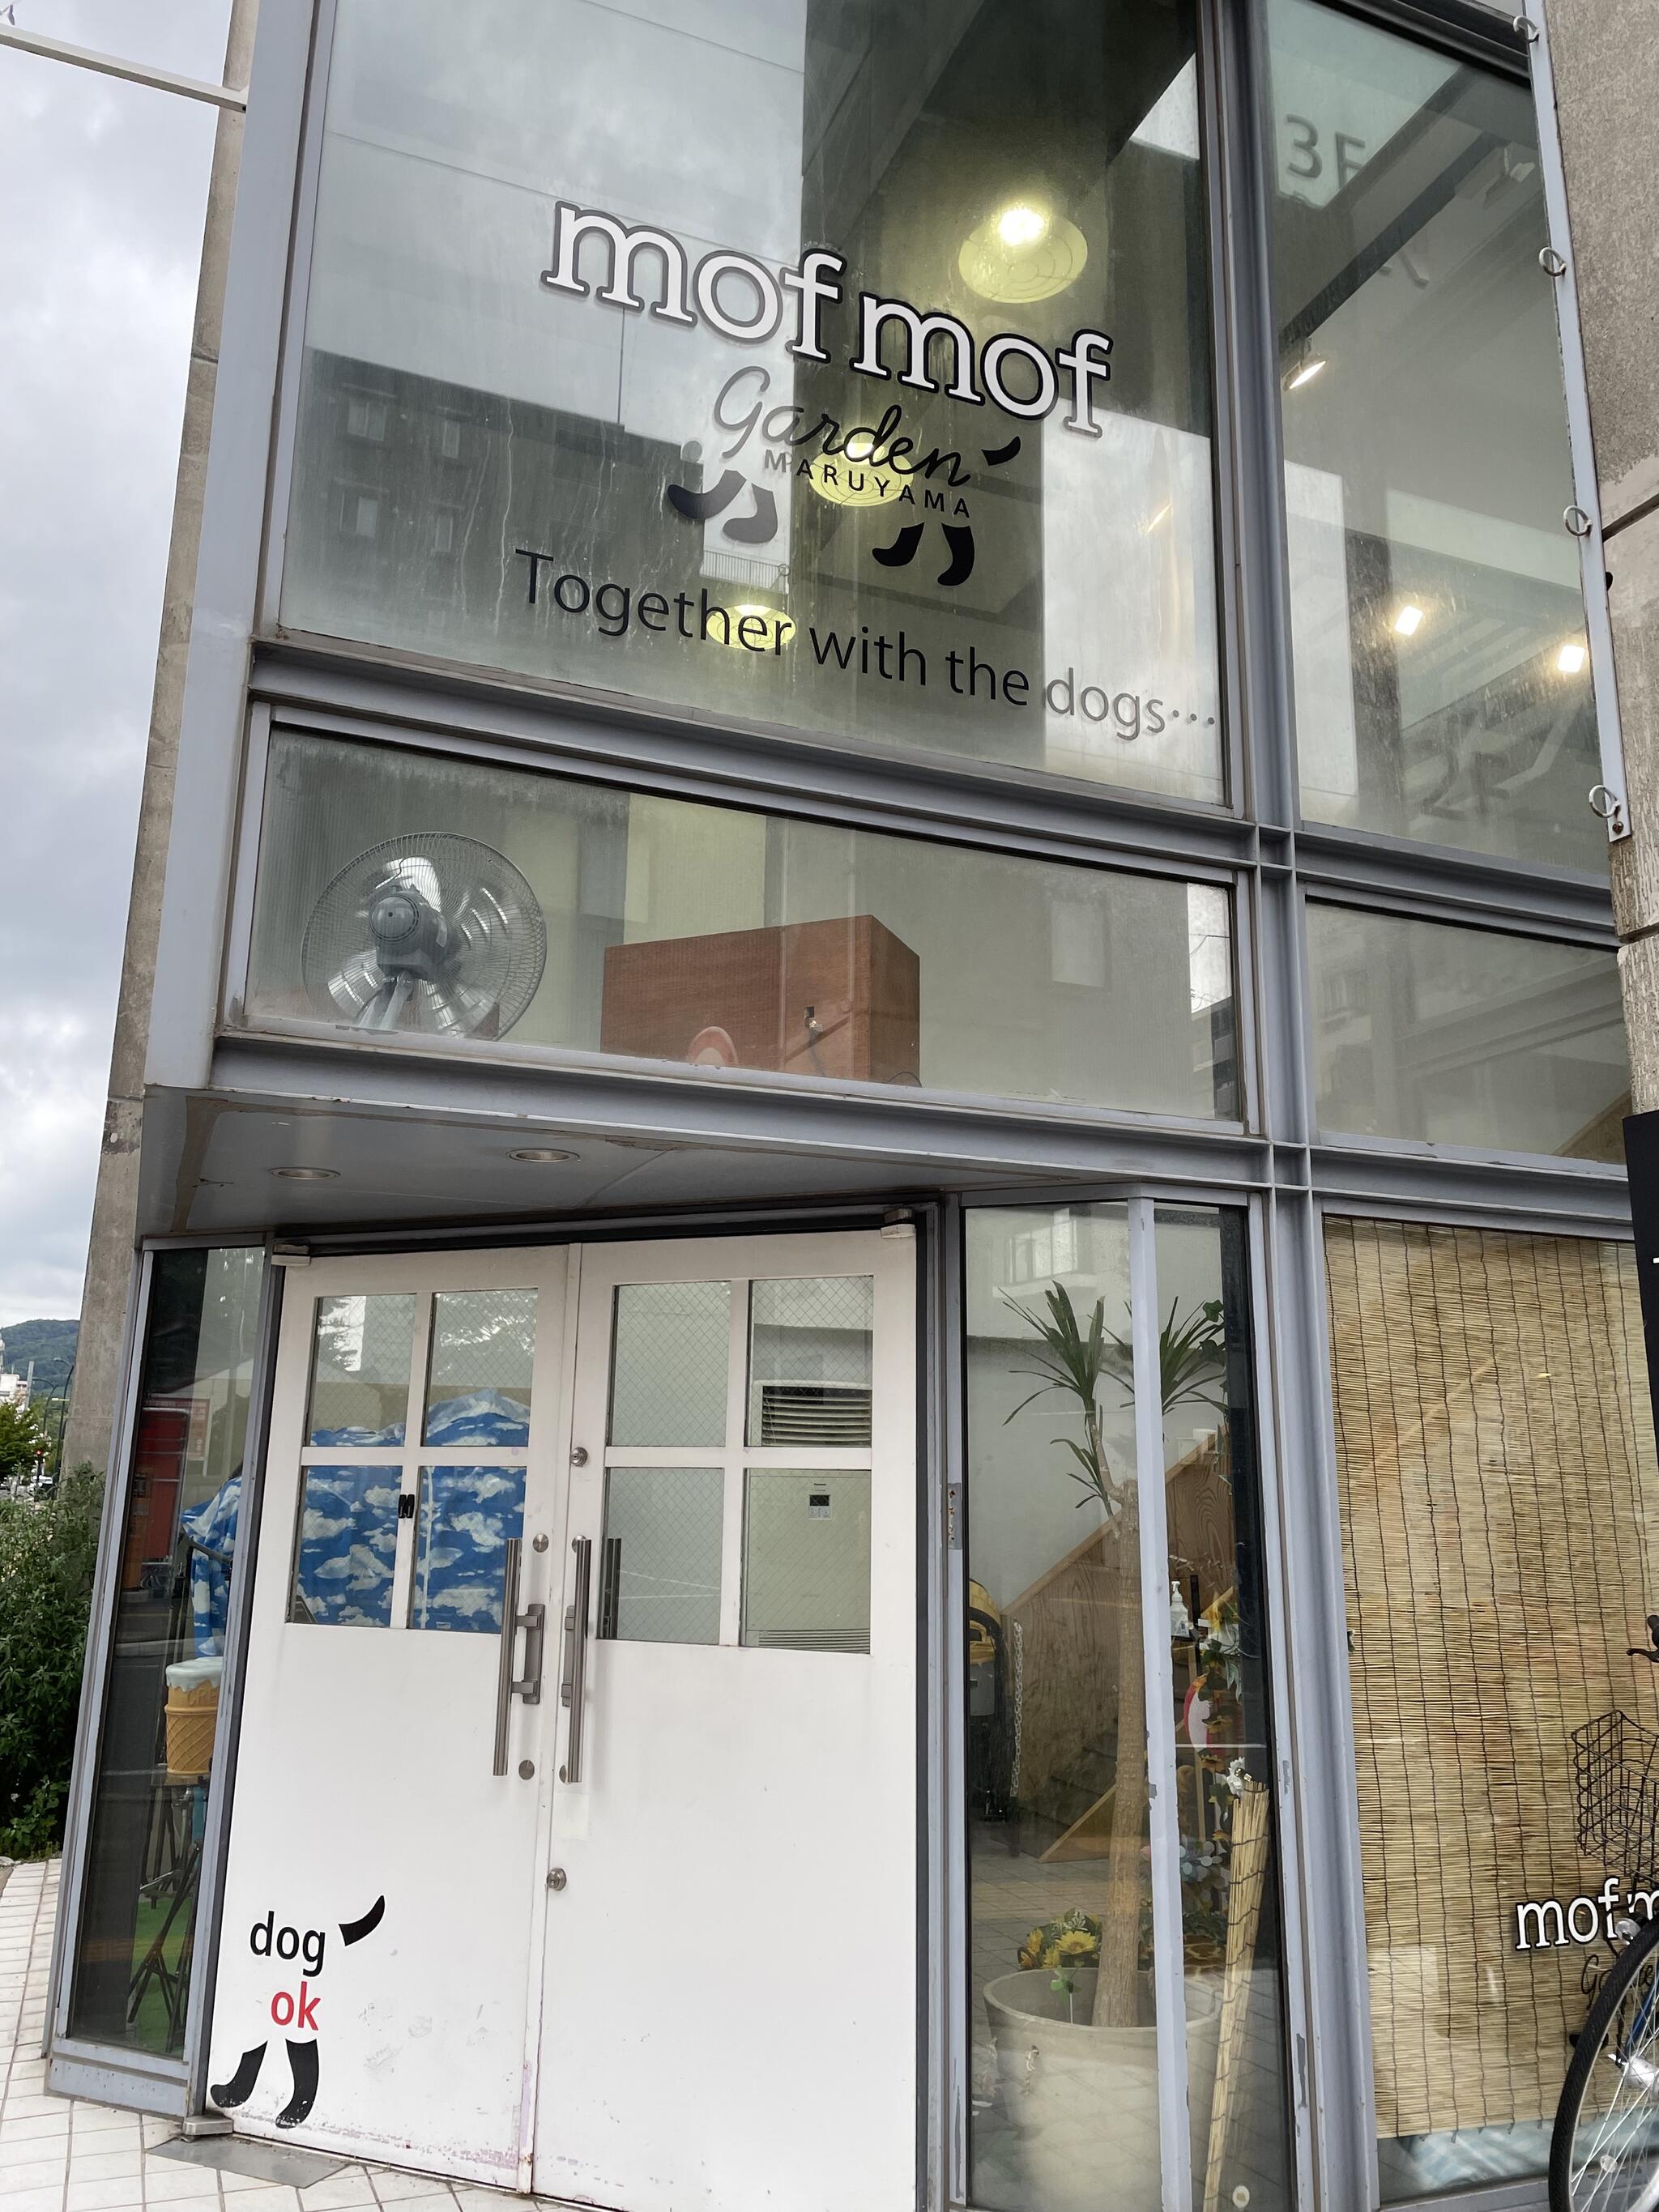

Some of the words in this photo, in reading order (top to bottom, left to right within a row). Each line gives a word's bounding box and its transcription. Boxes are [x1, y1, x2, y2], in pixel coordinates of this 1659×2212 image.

[541, 201, 845, 362] mof
[851, 291, 1113, 438] mof
[714, 365, 971, 487] Garden
[763, 449, 971, 518] MARUYAMA
[514, 548, 793, 656] Together
[809, 625, 928, 687] with
[944, 646, 1030, 706] the
[249, 1910, 326, 1978] dog
[271, 1980, 322, 2031] ok
